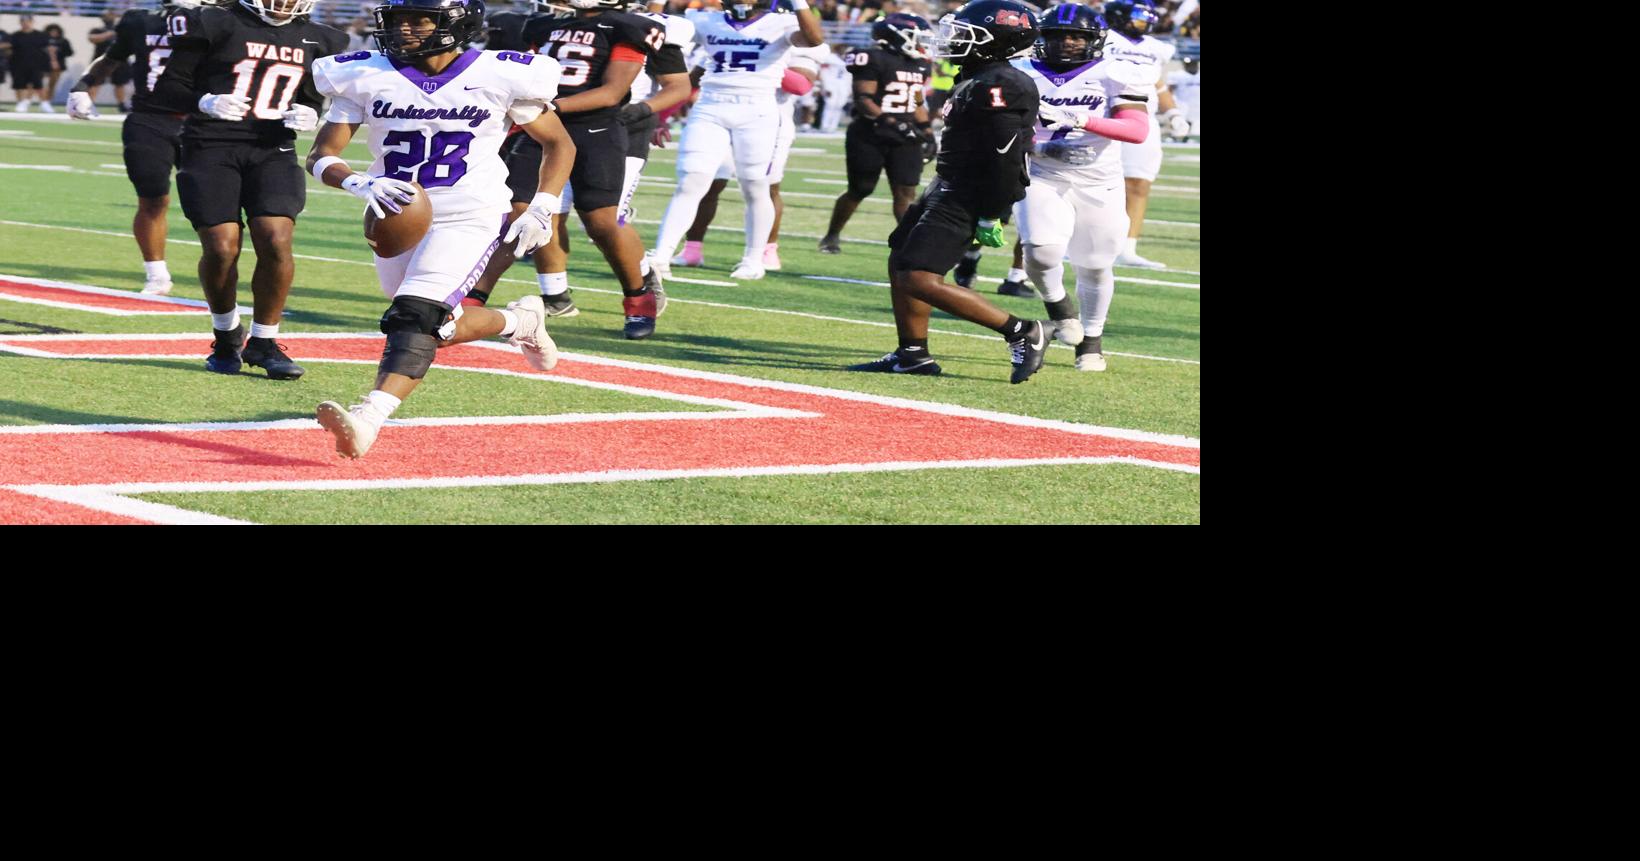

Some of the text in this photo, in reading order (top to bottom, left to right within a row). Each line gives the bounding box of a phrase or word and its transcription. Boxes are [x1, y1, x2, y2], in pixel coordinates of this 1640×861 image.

[550, 29, 595, 45] WACO
[246, 42, 304, 64] WACO
[713, 51, 760, 73] 15
[232, 59, 304, 120] 10
[988, 86, 1008, 108] 1
[372, 100, 491, 128] University
[382, 131, 476, 189] 28
